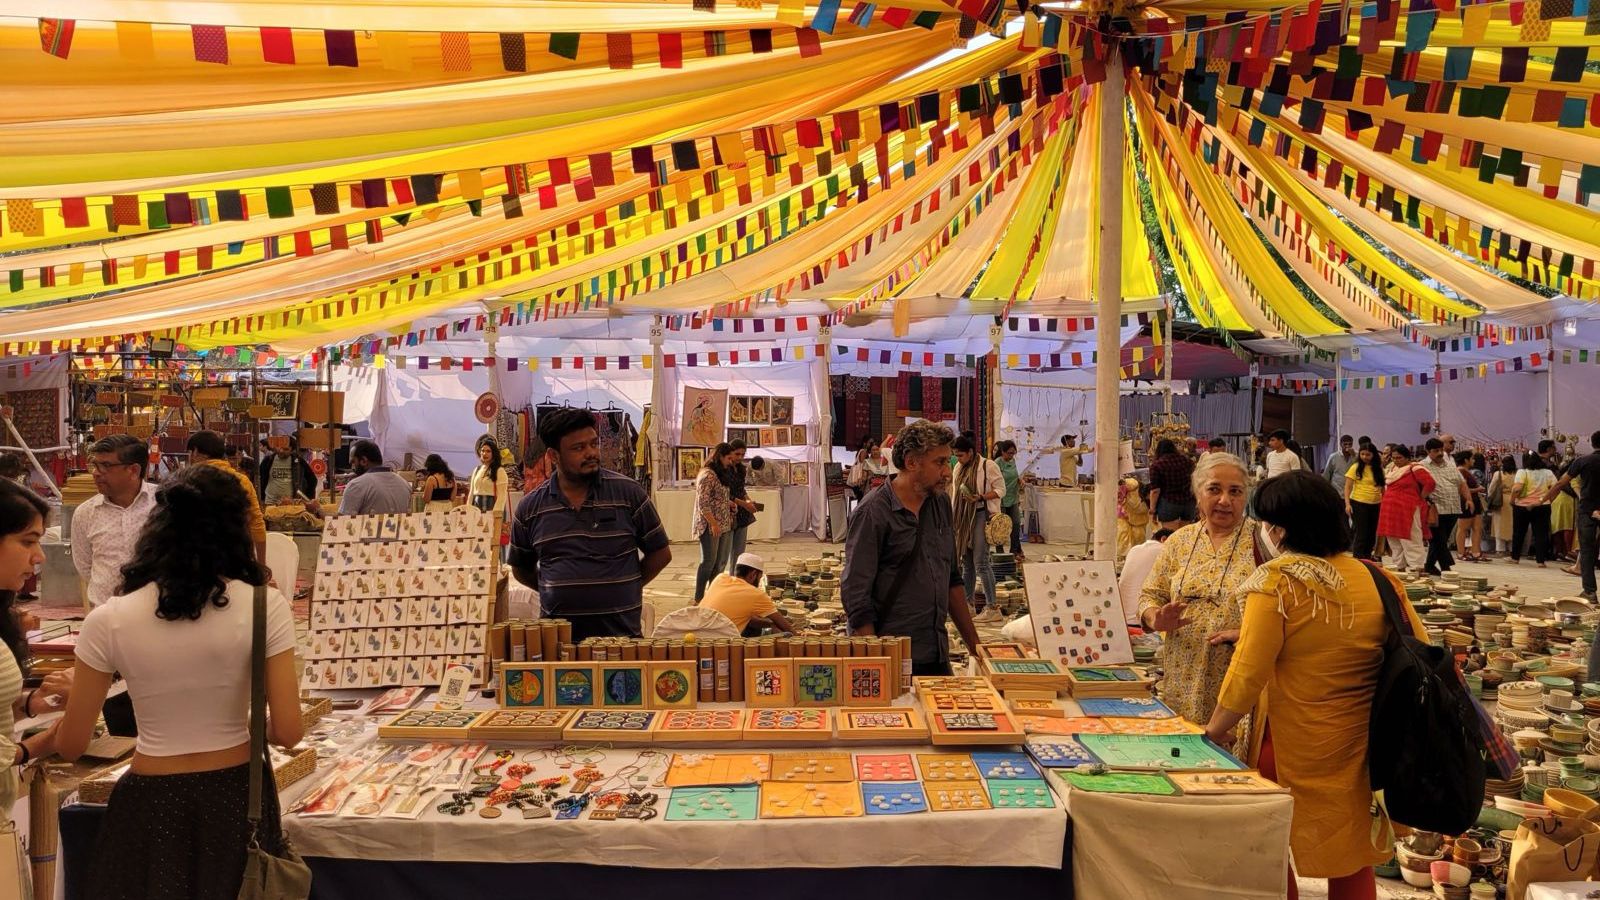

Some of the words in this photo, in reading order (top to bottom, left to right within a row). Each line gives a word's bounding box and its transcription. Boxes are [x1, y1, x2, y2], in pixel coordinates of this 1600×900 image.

[651, 328, 662, 336] 95
[819, 327, 830, 335] 96
[991, 328, 1001, 336] 97
